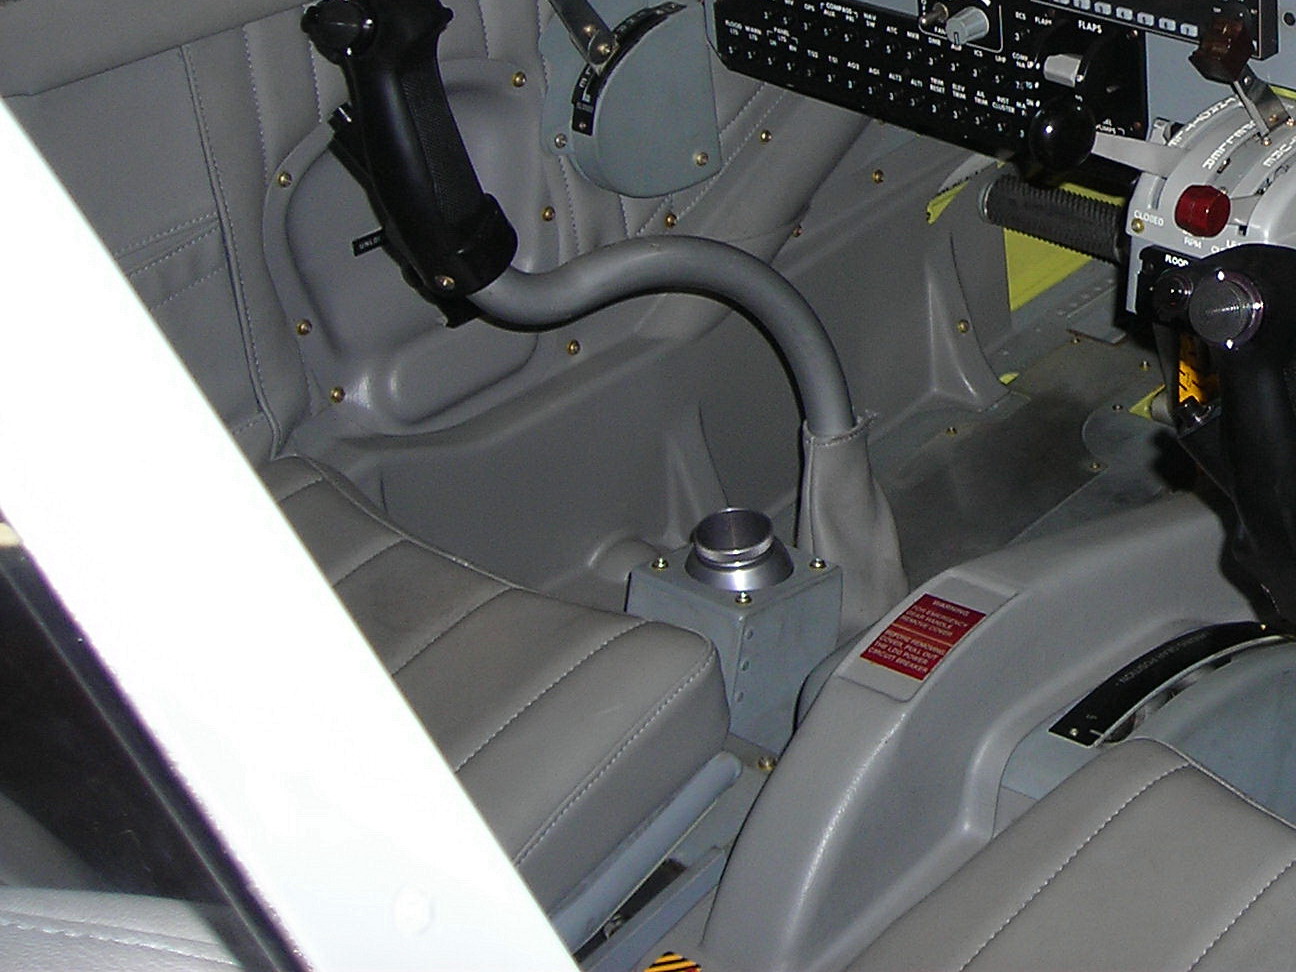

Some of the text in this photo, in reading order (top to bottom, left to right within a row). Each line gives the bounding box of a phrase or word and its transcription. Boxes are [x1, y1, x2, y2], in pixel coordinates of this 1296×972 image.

[1078, 20, 1103, 34] FLAPS
[1134, 210, 1164, 227] CLOSED
[932, 599, 971, 617] WARNING
[899, 614, 954, 637] REMOVE COVER
[924, 615, 953, 629] HANDLE
[926, 609, 969, 628] EMERGENCY
[884, 629, 946, 655] BEFORE REMOVING
[868, 646, 929, 674] CIRCUIT BREAKER
[873, 640, 888, 650] THE
[902, 649, 929, 666] POWER
[904, 643, 939, 660] PULL OUT
